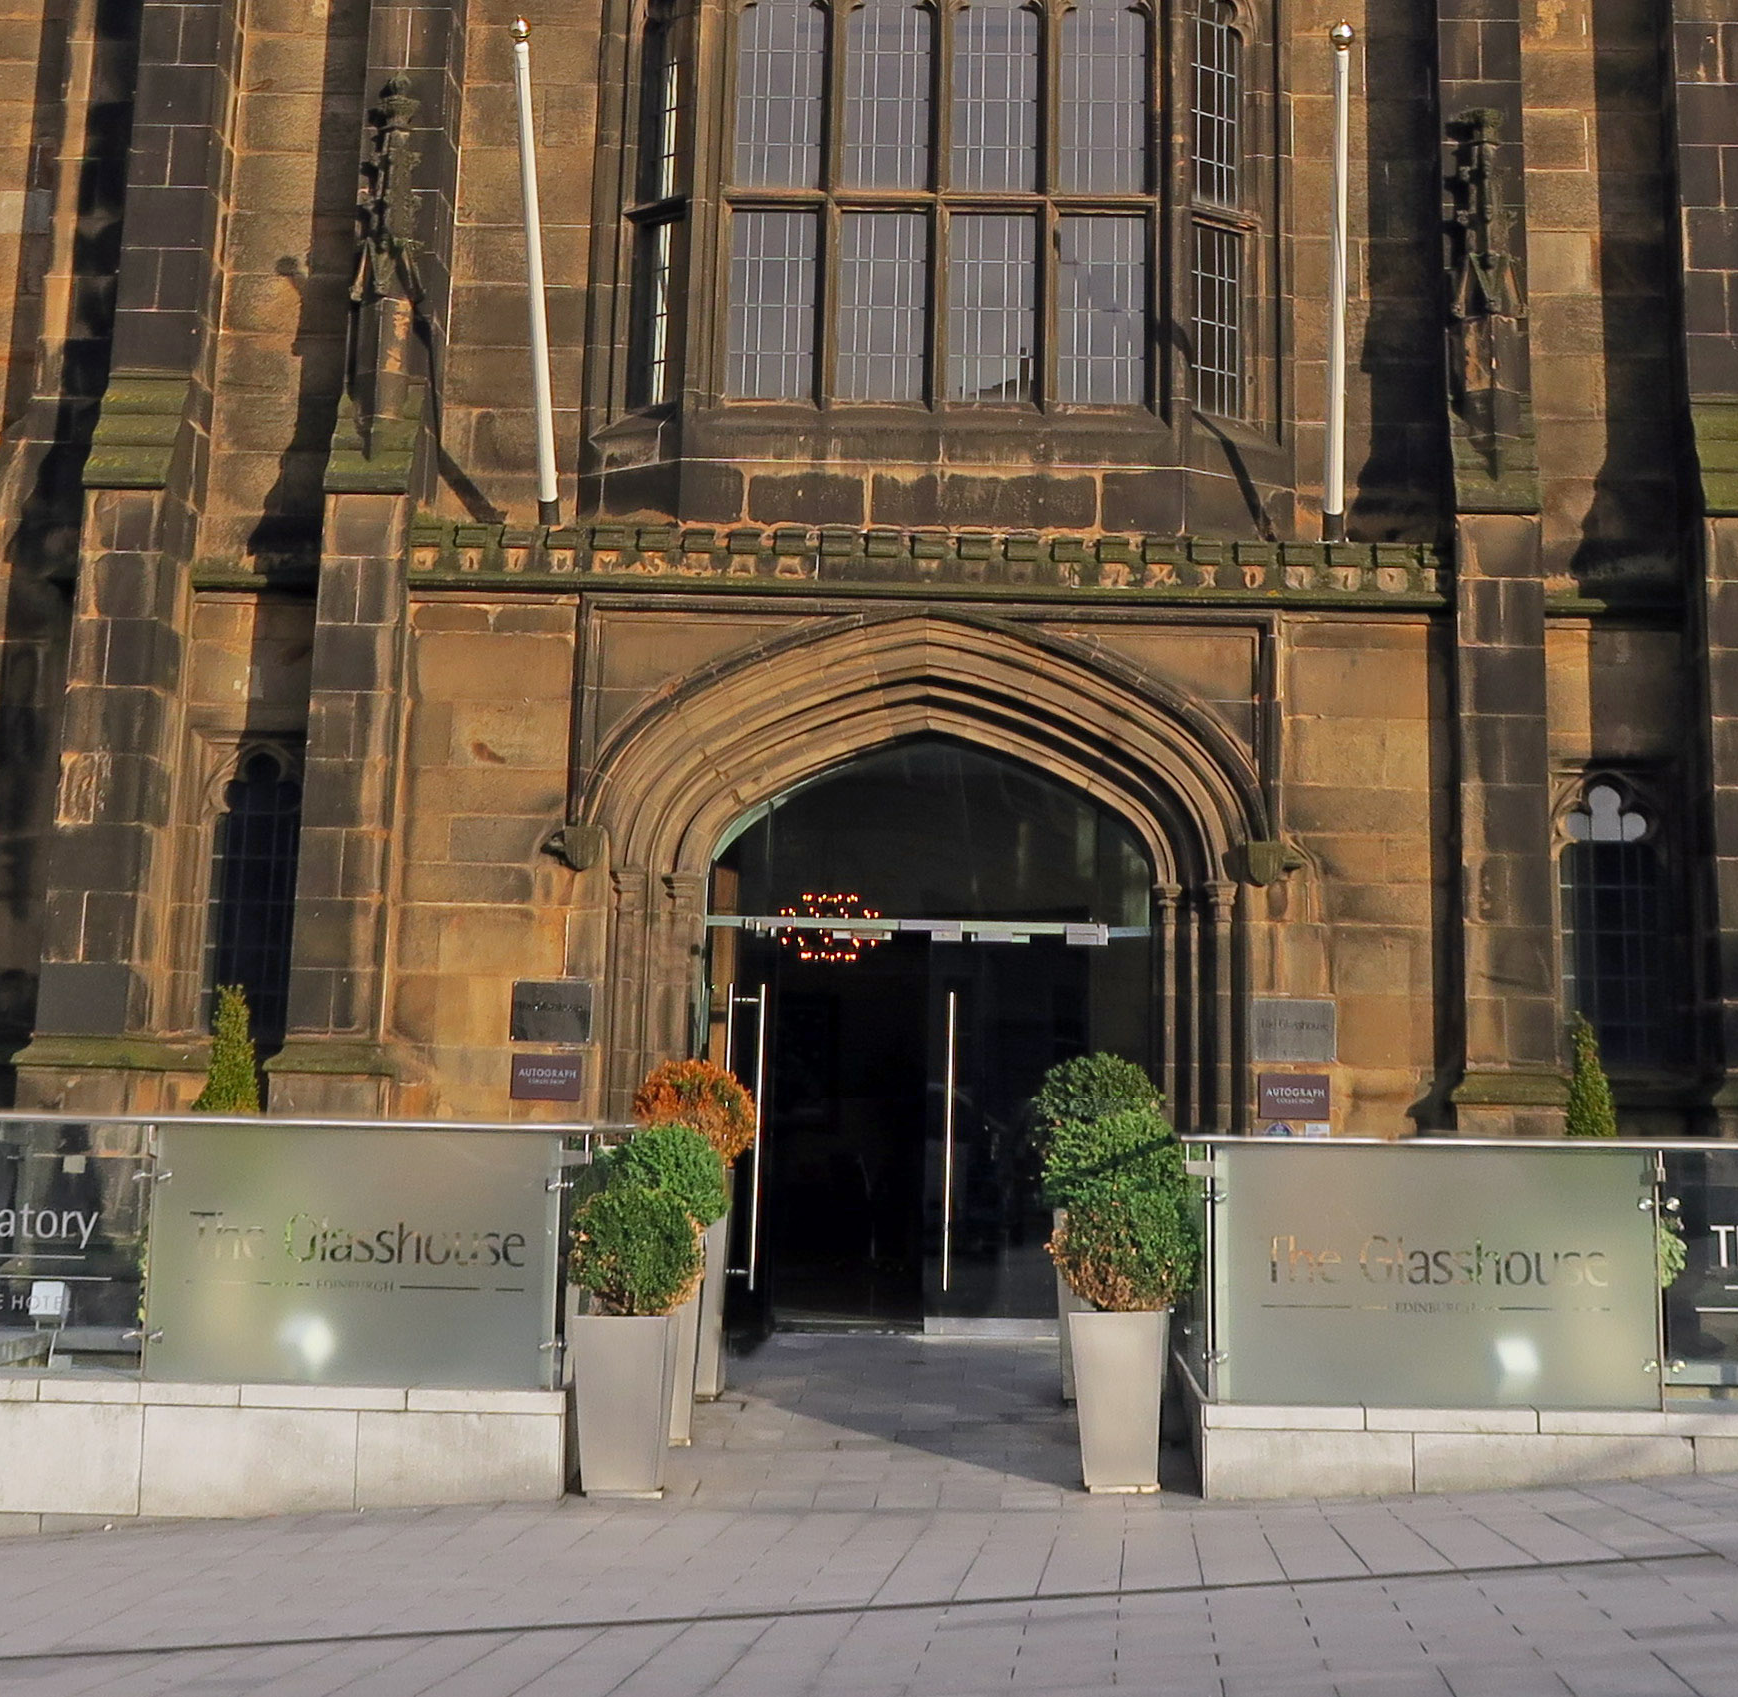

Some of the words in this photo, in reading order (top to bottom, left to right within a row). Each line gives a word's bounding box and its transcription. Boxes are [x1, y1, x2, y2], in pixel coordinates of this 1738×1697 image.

[518, 1067, 577, 1079] AUTOGRAPH
[1266, 1087, 1326, 1098] AUTOGRAPH
[283, 1211, 527, 1268] Glasshouse
[1269, 1234, 1343, 1284] The
[1358, 1234, 1610, 1288] Glasshouse
